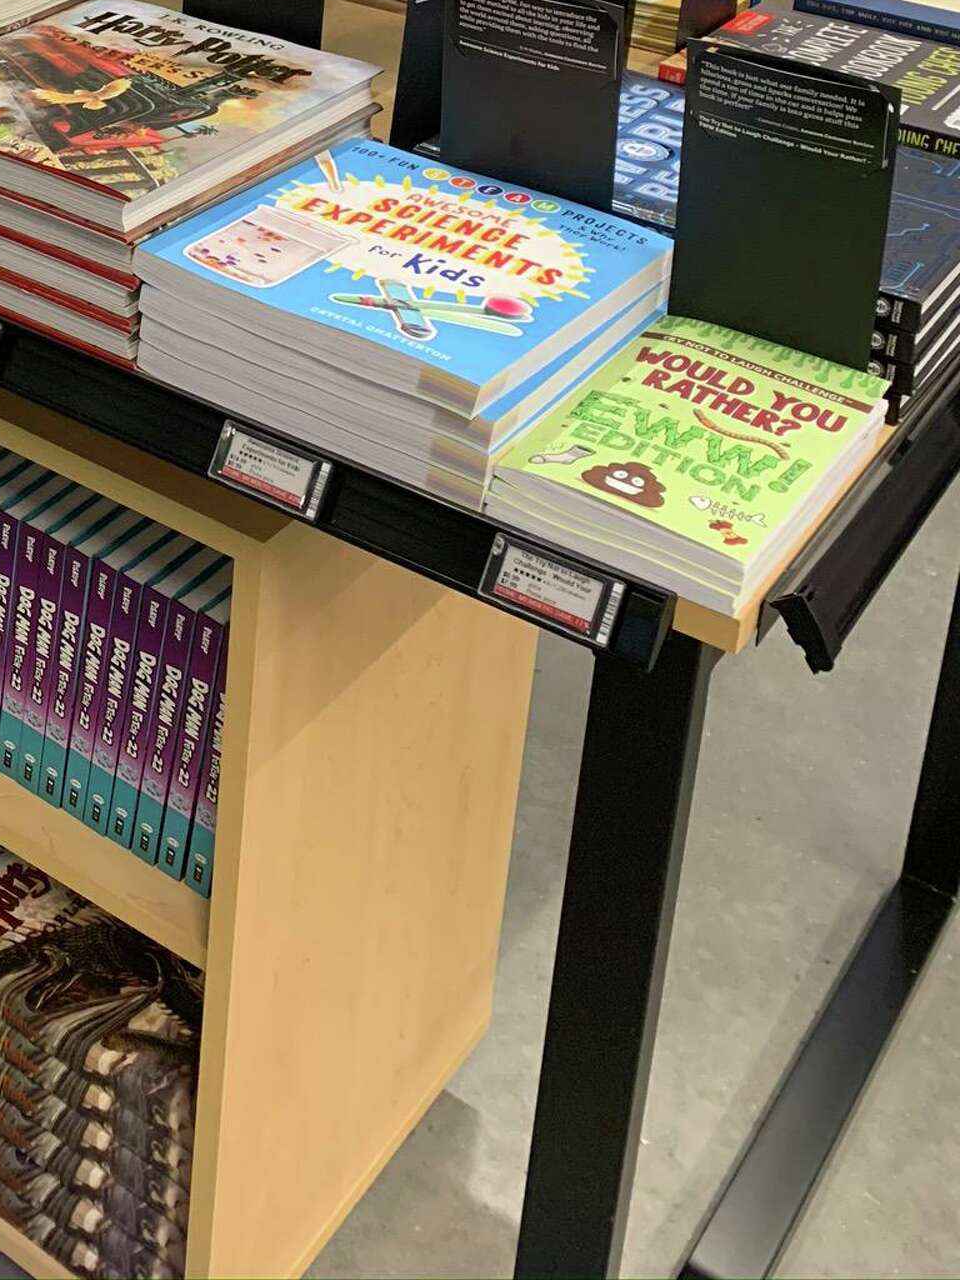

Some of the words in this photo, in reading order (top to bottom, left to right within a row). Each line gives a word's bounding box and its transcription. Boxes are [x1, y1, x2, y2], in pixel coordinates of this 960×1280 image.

[74, 11, 193, 48] Harry
[173, 36, 312, 85] Potter
[195, 24, 285, 52] ROWLING
[840, 33, 923, 80] OOKBOOK
[350, 145, 387, 161] 100+
[387, 154, 420, 171] FUN
[423, 168, 561, 213] STEAM
[561, 209, 650, 246] PROJECTS
[406, 193, 514, 229] AWESOME
[299, 196, 563, 287] EXPERIMENTS
[372, 196, 532, 251] SCIENCE
[368, 244, 402, 260] for
[402, 252, 487, 288] Kids
[309, 306, 367, 330] CRYSTAL
[366, 322, 452, 362] CHATTERTON
[663, 334, 685, 348] TRY
[686, 341, 711, 357] NOT
[711, 350, 727, 362] TO
[728, 354, 771, 376] LAUGH
[635, 345, 756, 398] WOULD
[770, 389, 850, 433] YOU
[642, 369, 805, 437] RATHER?
[570, 389, 814, 495] EWW!
[570, 421, 762, 503] EDITION
[87, 622, 106, 656] DOG
[110, 636, 131, 672] DOG
[84, 651, 101, 685] MAN
[107, 665, 125, 700] MAN
[136, 650, 157, 685] DOG
[161, 663, 182, 699] DOG
[132, 678, 151, 713] MAN
[158, 691, 176, 728] MAN
[187, 676, 209, 713] DOG
[185, 704, 203, 741] MAN
